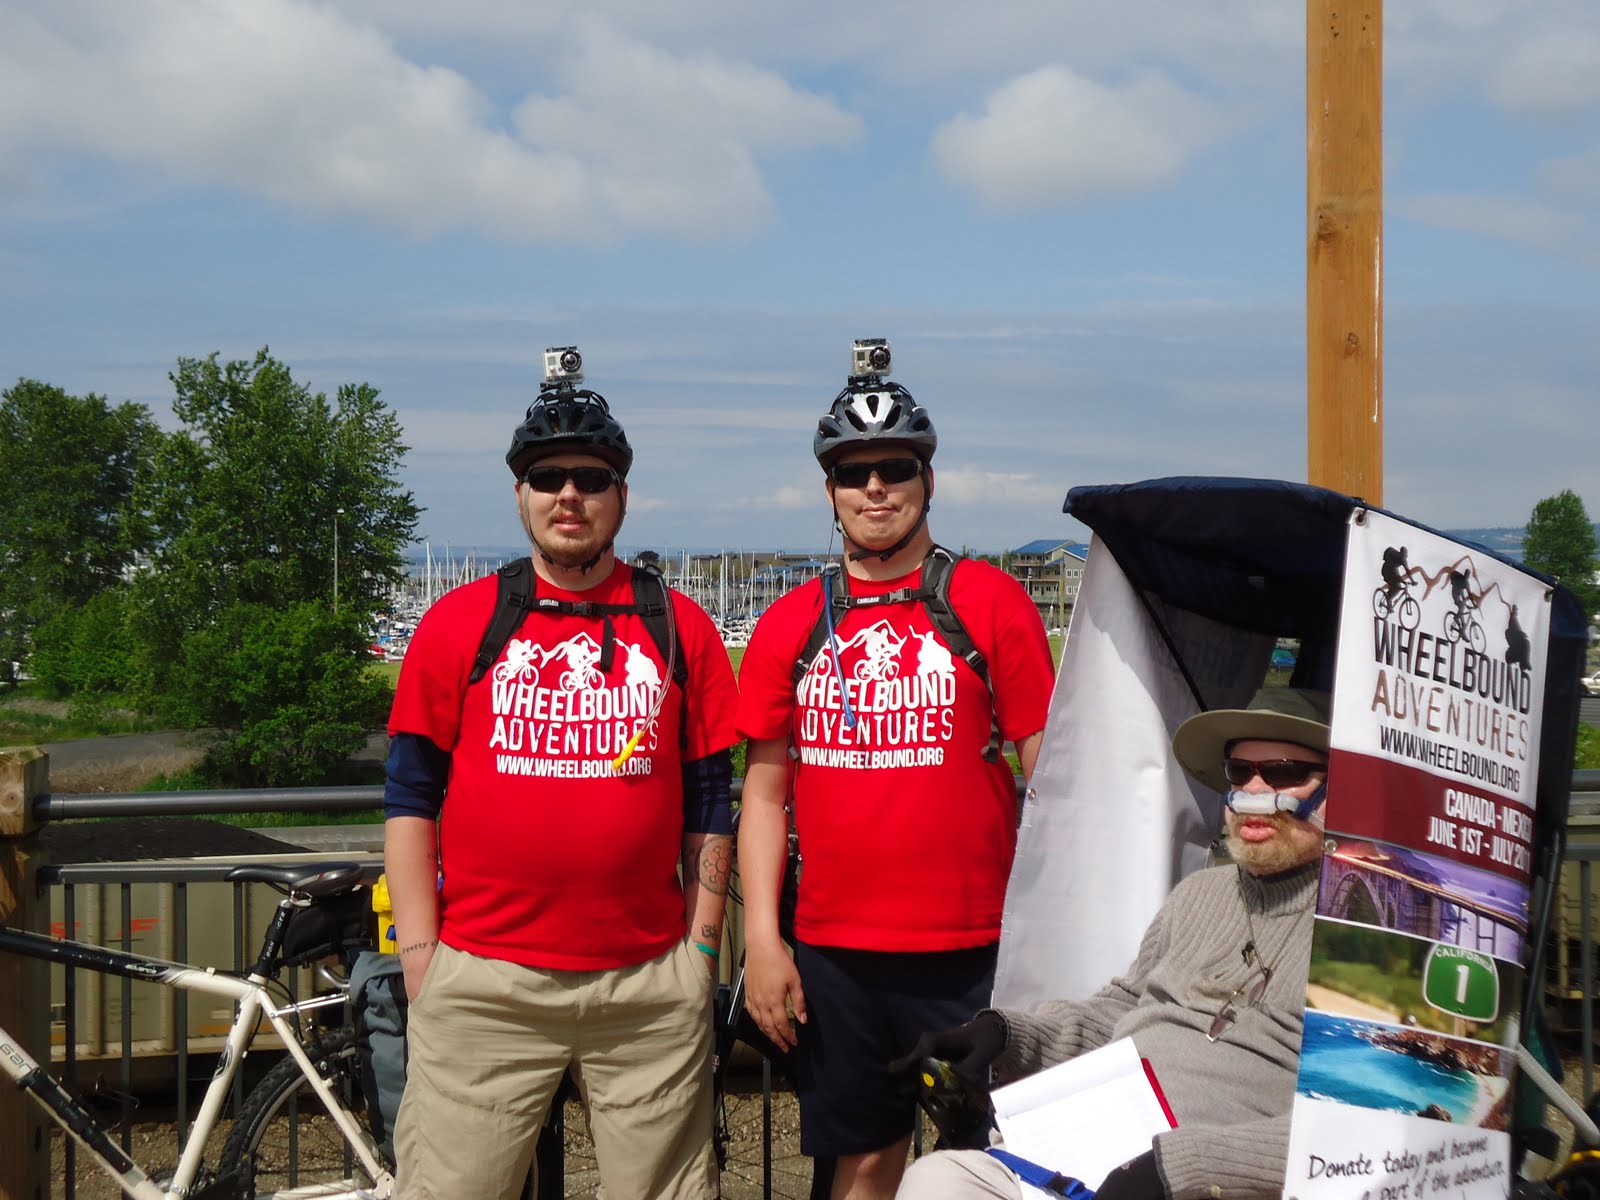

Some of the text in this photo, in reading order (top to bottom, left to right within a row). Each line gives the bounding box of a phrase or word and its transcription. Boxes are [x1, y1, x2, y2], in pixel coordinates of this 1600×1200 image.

[1373, 617, 1532, 715] WHEELBOUND
[492, 681, 662, 722] WHEELBOUND
[797, 672, 956, 713] WHEELBOUND
[489, 716, 658, 755] ADVENTURES
[1371, 669, 1528, 761] ADVENTURES
[801, 746, 944, 769] WWW.WHEELBOUND.ORG
[1380, 725, 1521, 794] WWW.WHEELBOUND.ORG
[1445, 788, 1496, 829] CANADA
[1427, 816, 1457, 849] JUNE
[1460, 827, 1483, 856] 1ST
[1490, 835, 1515, 866] JULY
[1456, 964, 1469, 1004] 1
[1307, 1152, 1374, 1180] Donate
[1383, 1148, 1421, 1179] today
[1425, 1140, 1446, 1166] and
[1380, 1177, 1409, 1200] part
[1414, 1167, 1429, 1200] of
[1431, 1167, 1450, 1192] the
